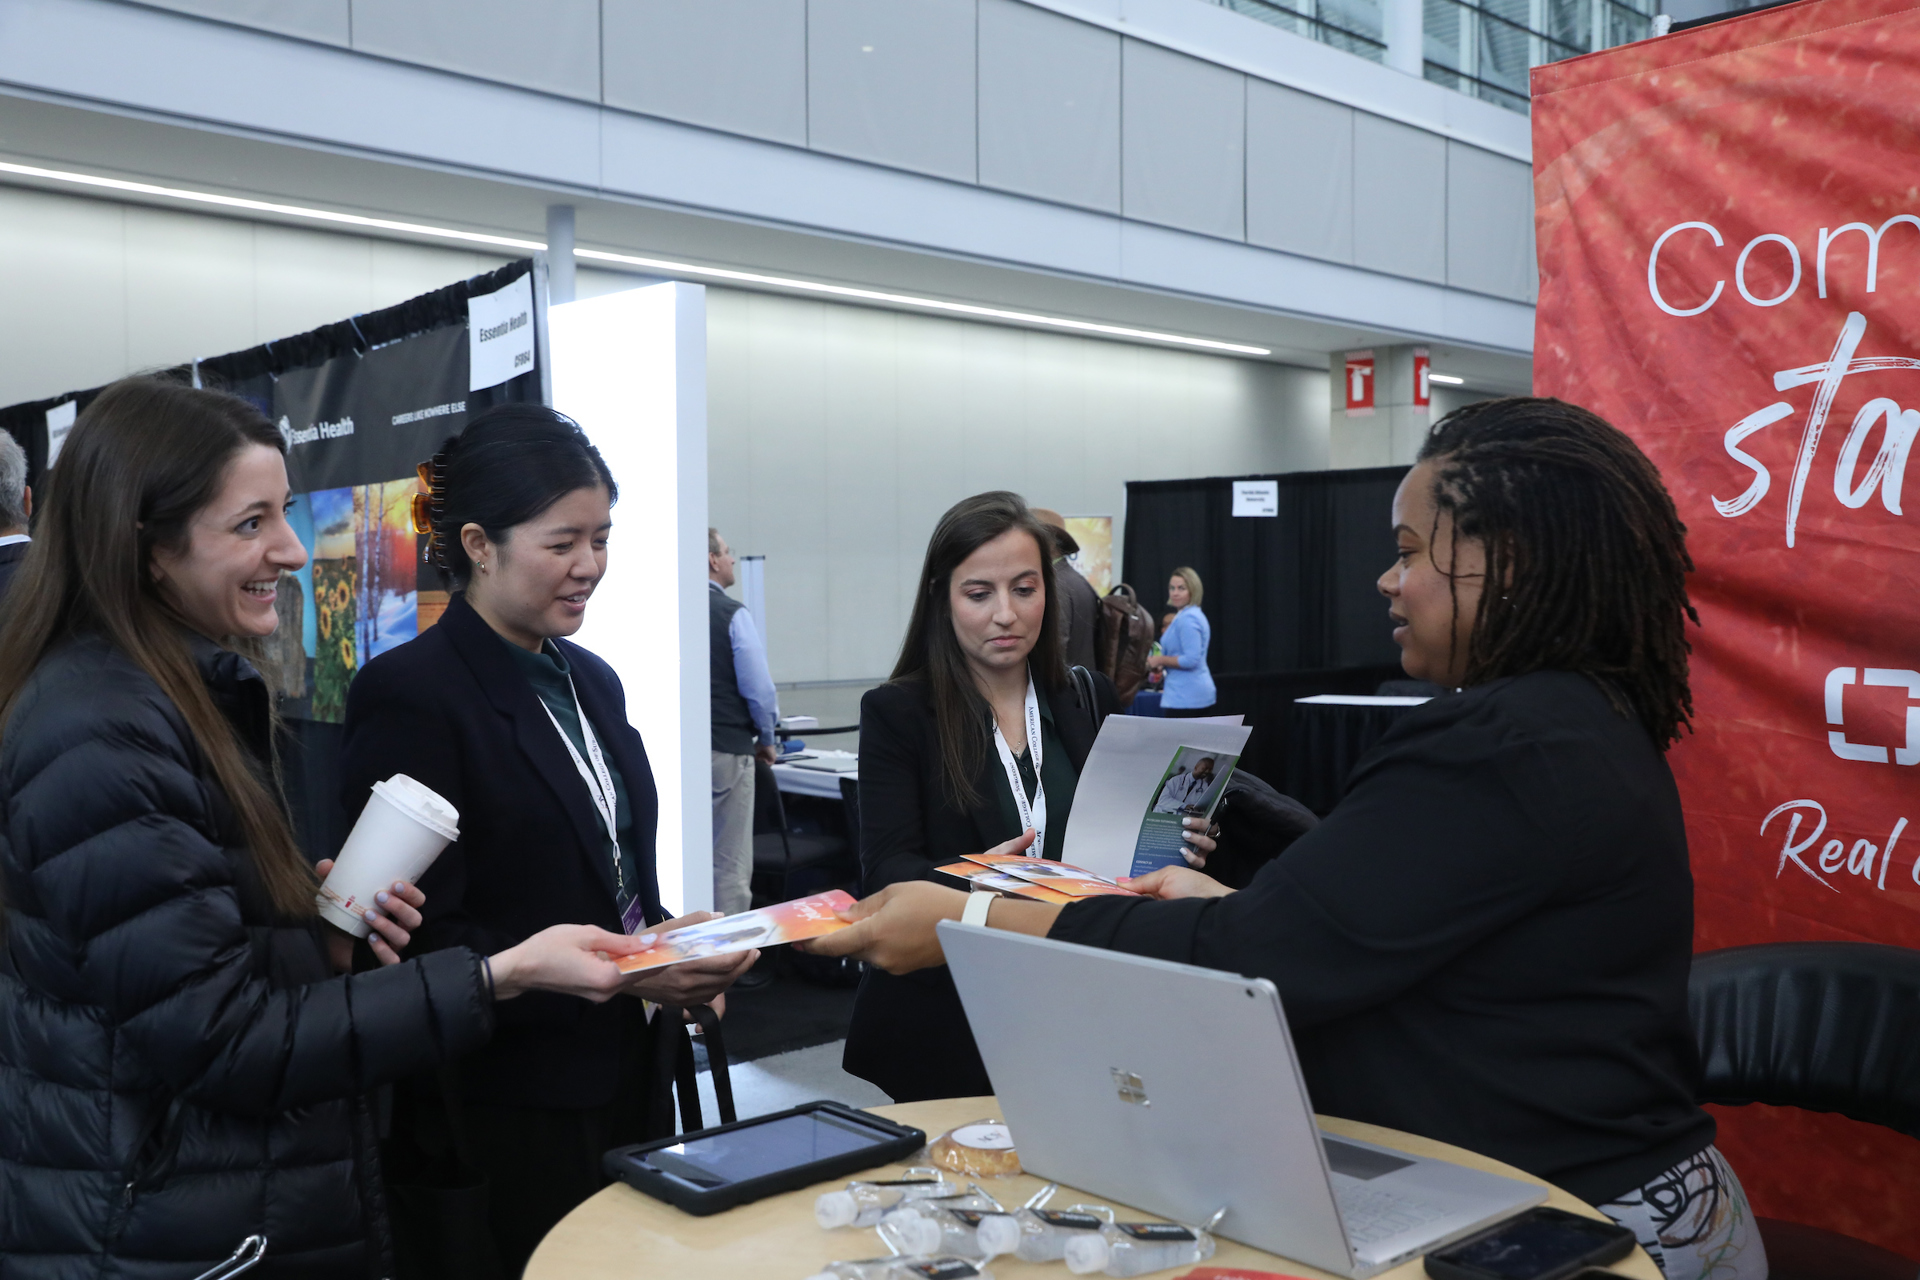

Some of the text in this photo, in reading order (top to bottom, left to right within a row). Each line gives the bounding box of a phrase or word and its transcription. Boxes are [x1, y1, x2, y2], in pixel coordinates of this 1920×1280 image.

[479, 311, 527, 343] Essentia Health
[392, 401, 466, 426] CAREERS LIKE NOWHERE ELSE
[319, 416, 354, 440] Health
[1028, 706, 1036, 736] AMERICAN
[1031, 736, 1039, 762] COLLEGE
[1020, 800, 1032, 828] COLLEGE
[1760, 798, 1909, 894] Real
